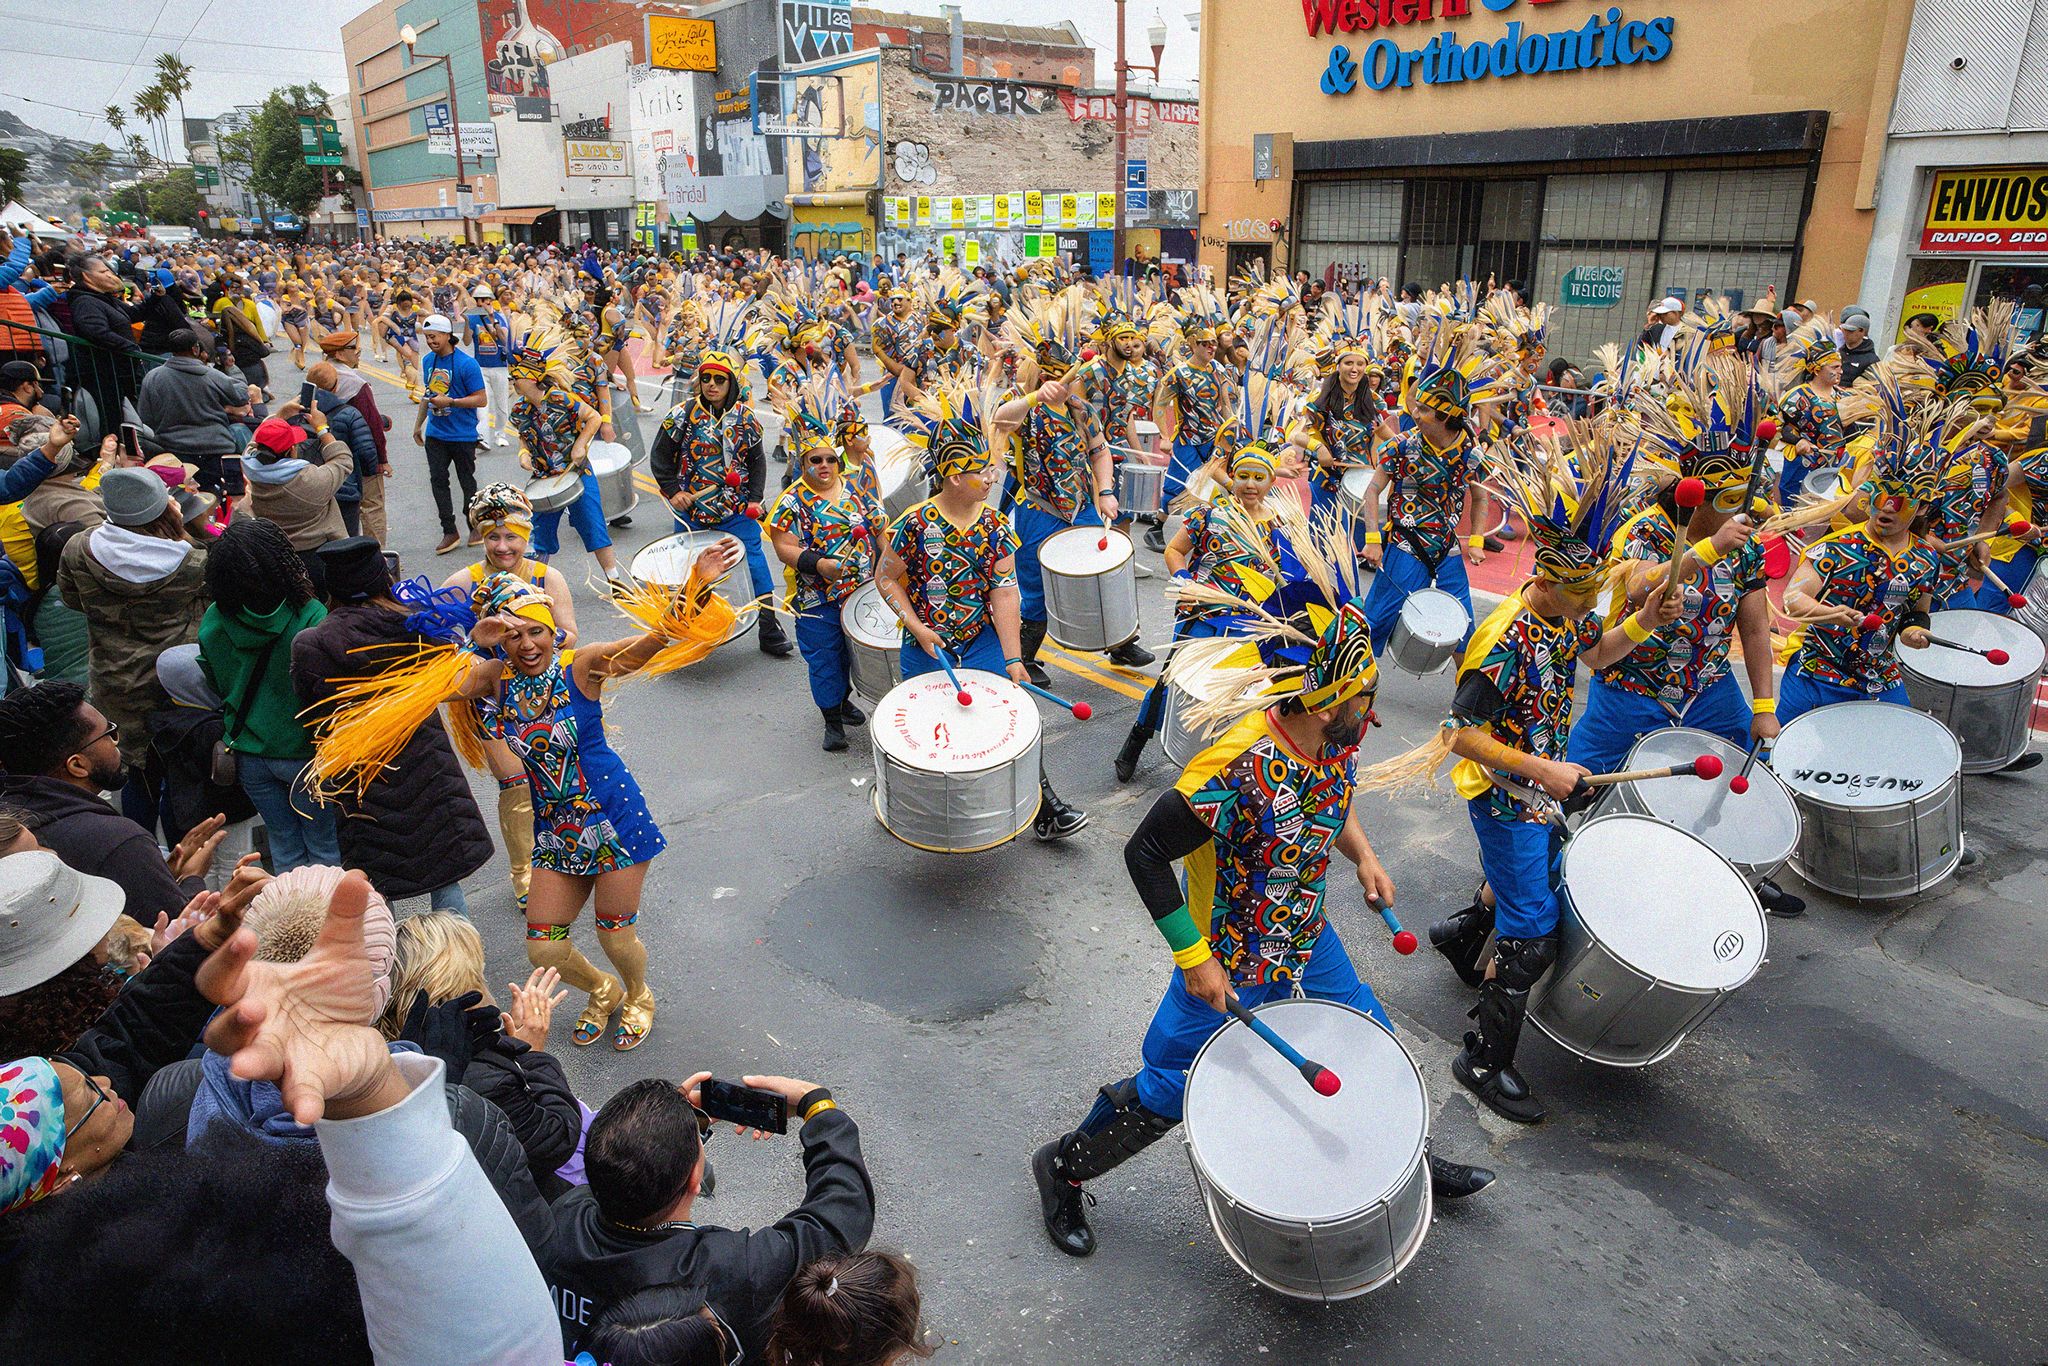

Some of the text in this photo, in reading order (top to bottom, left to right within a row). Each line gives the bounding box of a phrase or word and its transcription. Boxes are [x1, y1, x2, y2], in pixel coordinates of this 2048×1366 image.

[1319, 7, 1674, 96] & Orthodontics
[1934, 175, 2048, 222] ENVIOS
